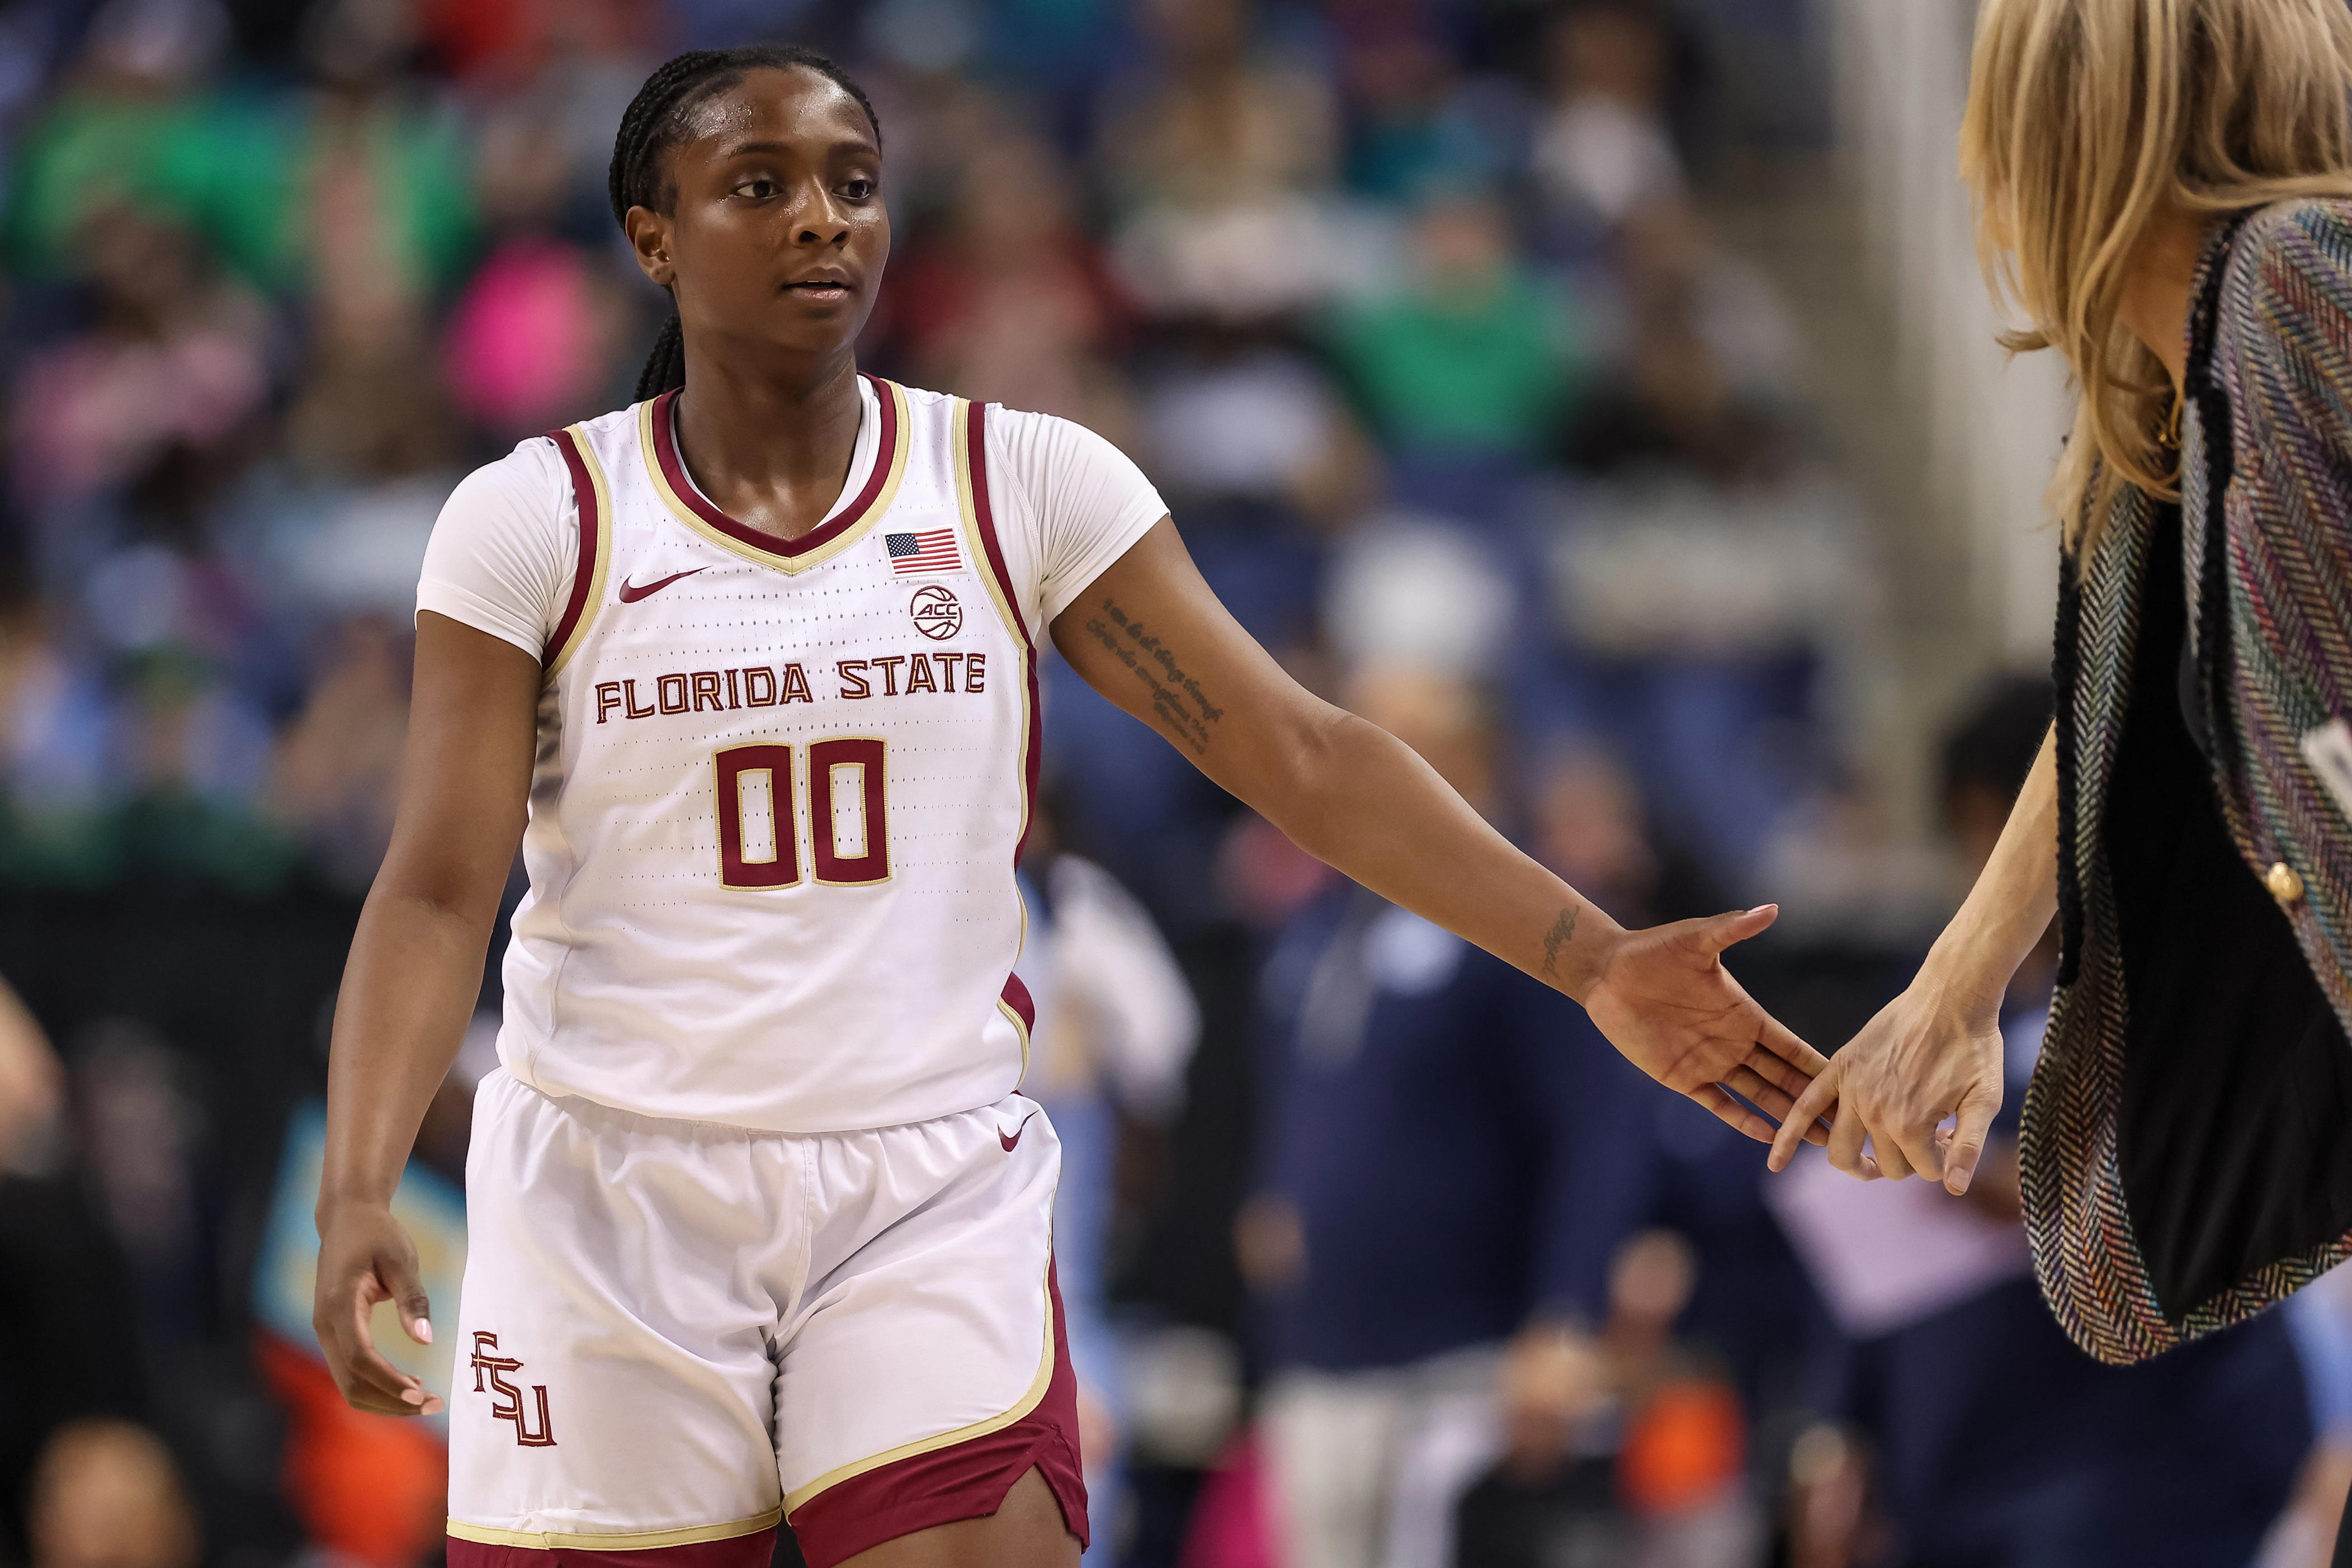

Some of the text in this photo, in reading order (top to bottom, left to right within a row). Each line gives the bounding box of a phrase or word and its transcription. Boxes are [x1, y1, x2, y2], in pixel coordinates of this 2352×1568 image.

[917, 603, 960, 616] ACC
[596, 653, 986, 724] FLORIDA STATE
[712, 735, 892, 891] 00
[470, 1331, 558, 1447] FSU
